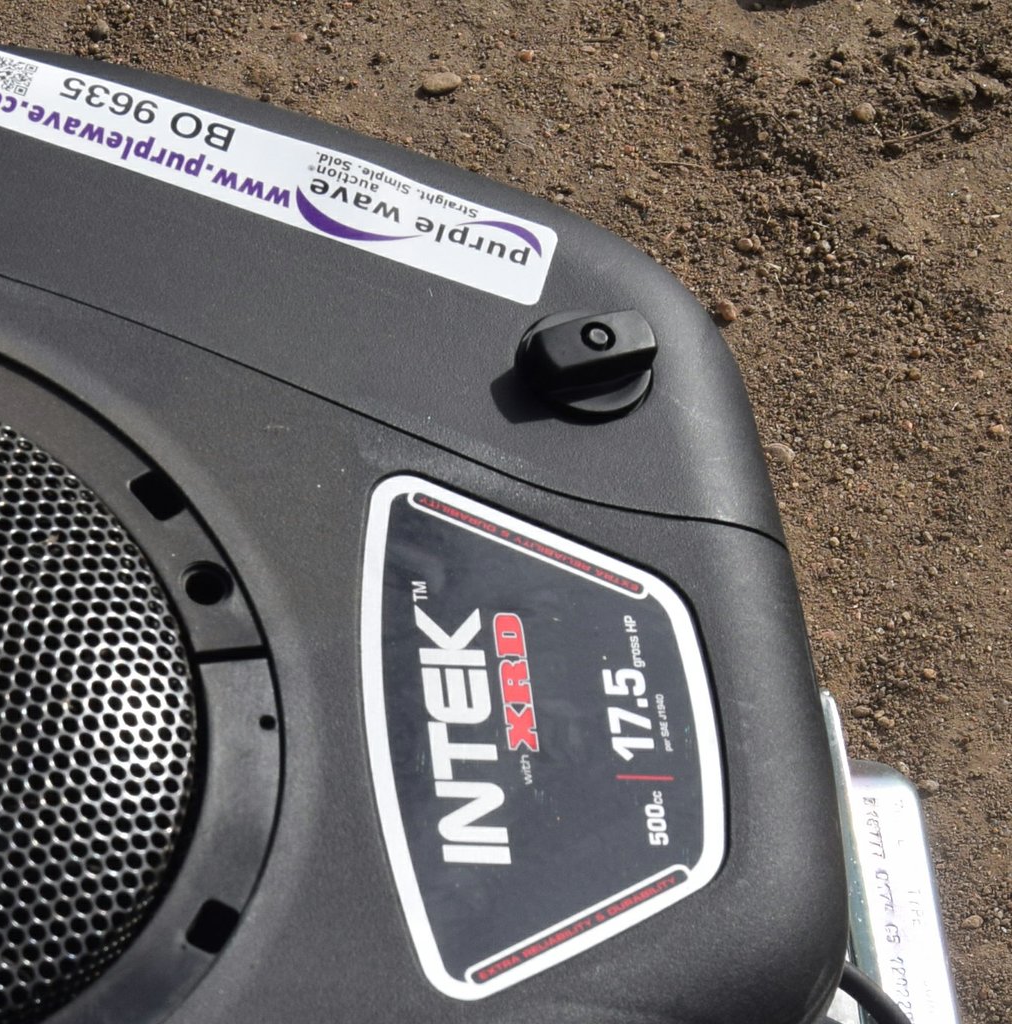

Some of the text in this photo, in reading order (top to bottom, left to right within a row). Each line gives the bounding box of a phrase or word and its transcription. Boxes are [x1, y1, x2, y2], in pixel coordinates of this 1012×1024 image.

[59, 77, 236, 152] BO 9635
[316, 151, 352, 171] Sold.
[309, 178, 531, 266] purple wave
[416, 187, 479, 218] Straight.
[419, 496, 496, 533] DURABILITY
[513, 536, 591, 572] RELIABILITY
[595, 568, 640, 592] EXTRA
[624, 615, 637, 633] HP
[629, 635, 646, 668] gross
[493, 612, 540, 785] with XRD
[602, 668, 655, 761] 17.5
[414, 604, 512, 865] INTEK
[655, 694, 673, 752] per SAE J1940
[478, 956, 520, 980] EXTRA
[522, 919, 592, 958] RELIABILITY
[607, 876, 677, 916] DURABILITY
